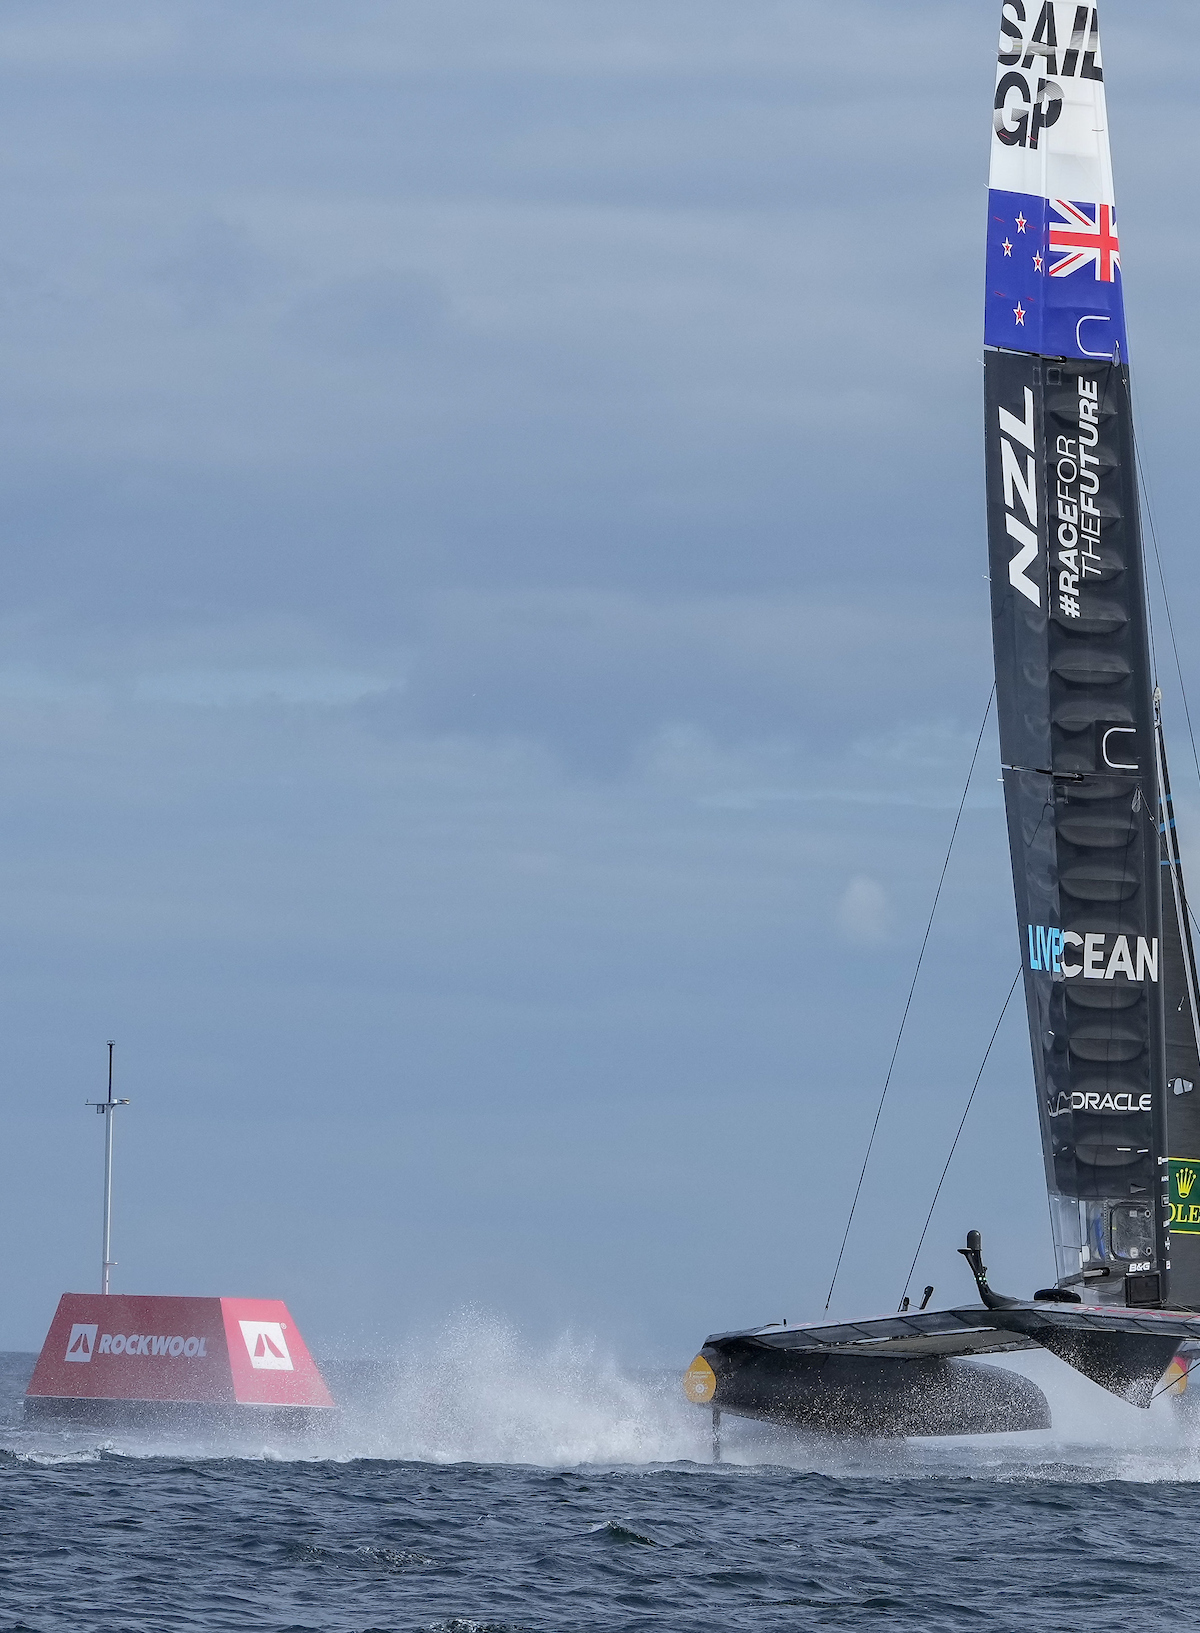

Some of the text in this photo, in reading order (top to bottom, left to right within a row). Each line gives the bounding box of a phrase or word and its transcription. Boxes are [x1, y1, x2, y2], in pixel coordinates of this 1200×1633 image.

[998, 0, 1103, 82] SAIL
[993, 71, 1064, 150] GP
[999, 386, 1041, 608] NZL
[1129, 1261, 1151, 1272] B&G
[98, 1333, 207, 1357] ROCKWOOL
